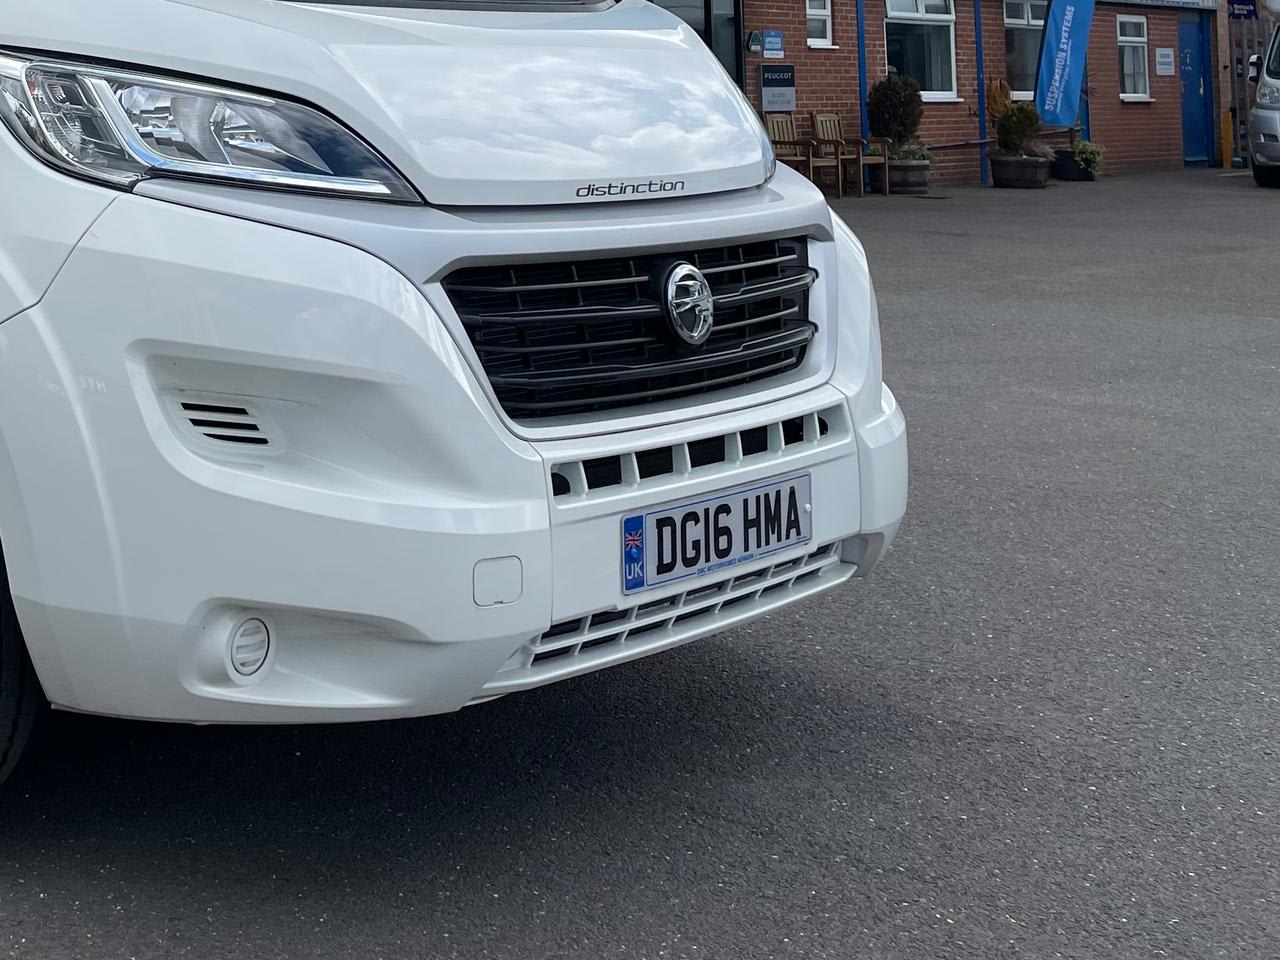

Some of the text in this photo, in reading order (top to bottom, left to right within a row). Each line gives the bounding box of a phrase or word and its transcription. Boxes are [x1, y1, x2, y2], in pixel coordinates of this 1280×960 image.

[1044, 51, 1067, 112] SUSPENSION
[1059, 4, 1075, 50] SYSTEMS
[764, 72, 792, 80] PEUGEOT
[575, 179, 685, 198] distinction
[655, 485, 801, 576] DG16 HMA
[625, 562, 643, 580] UK
